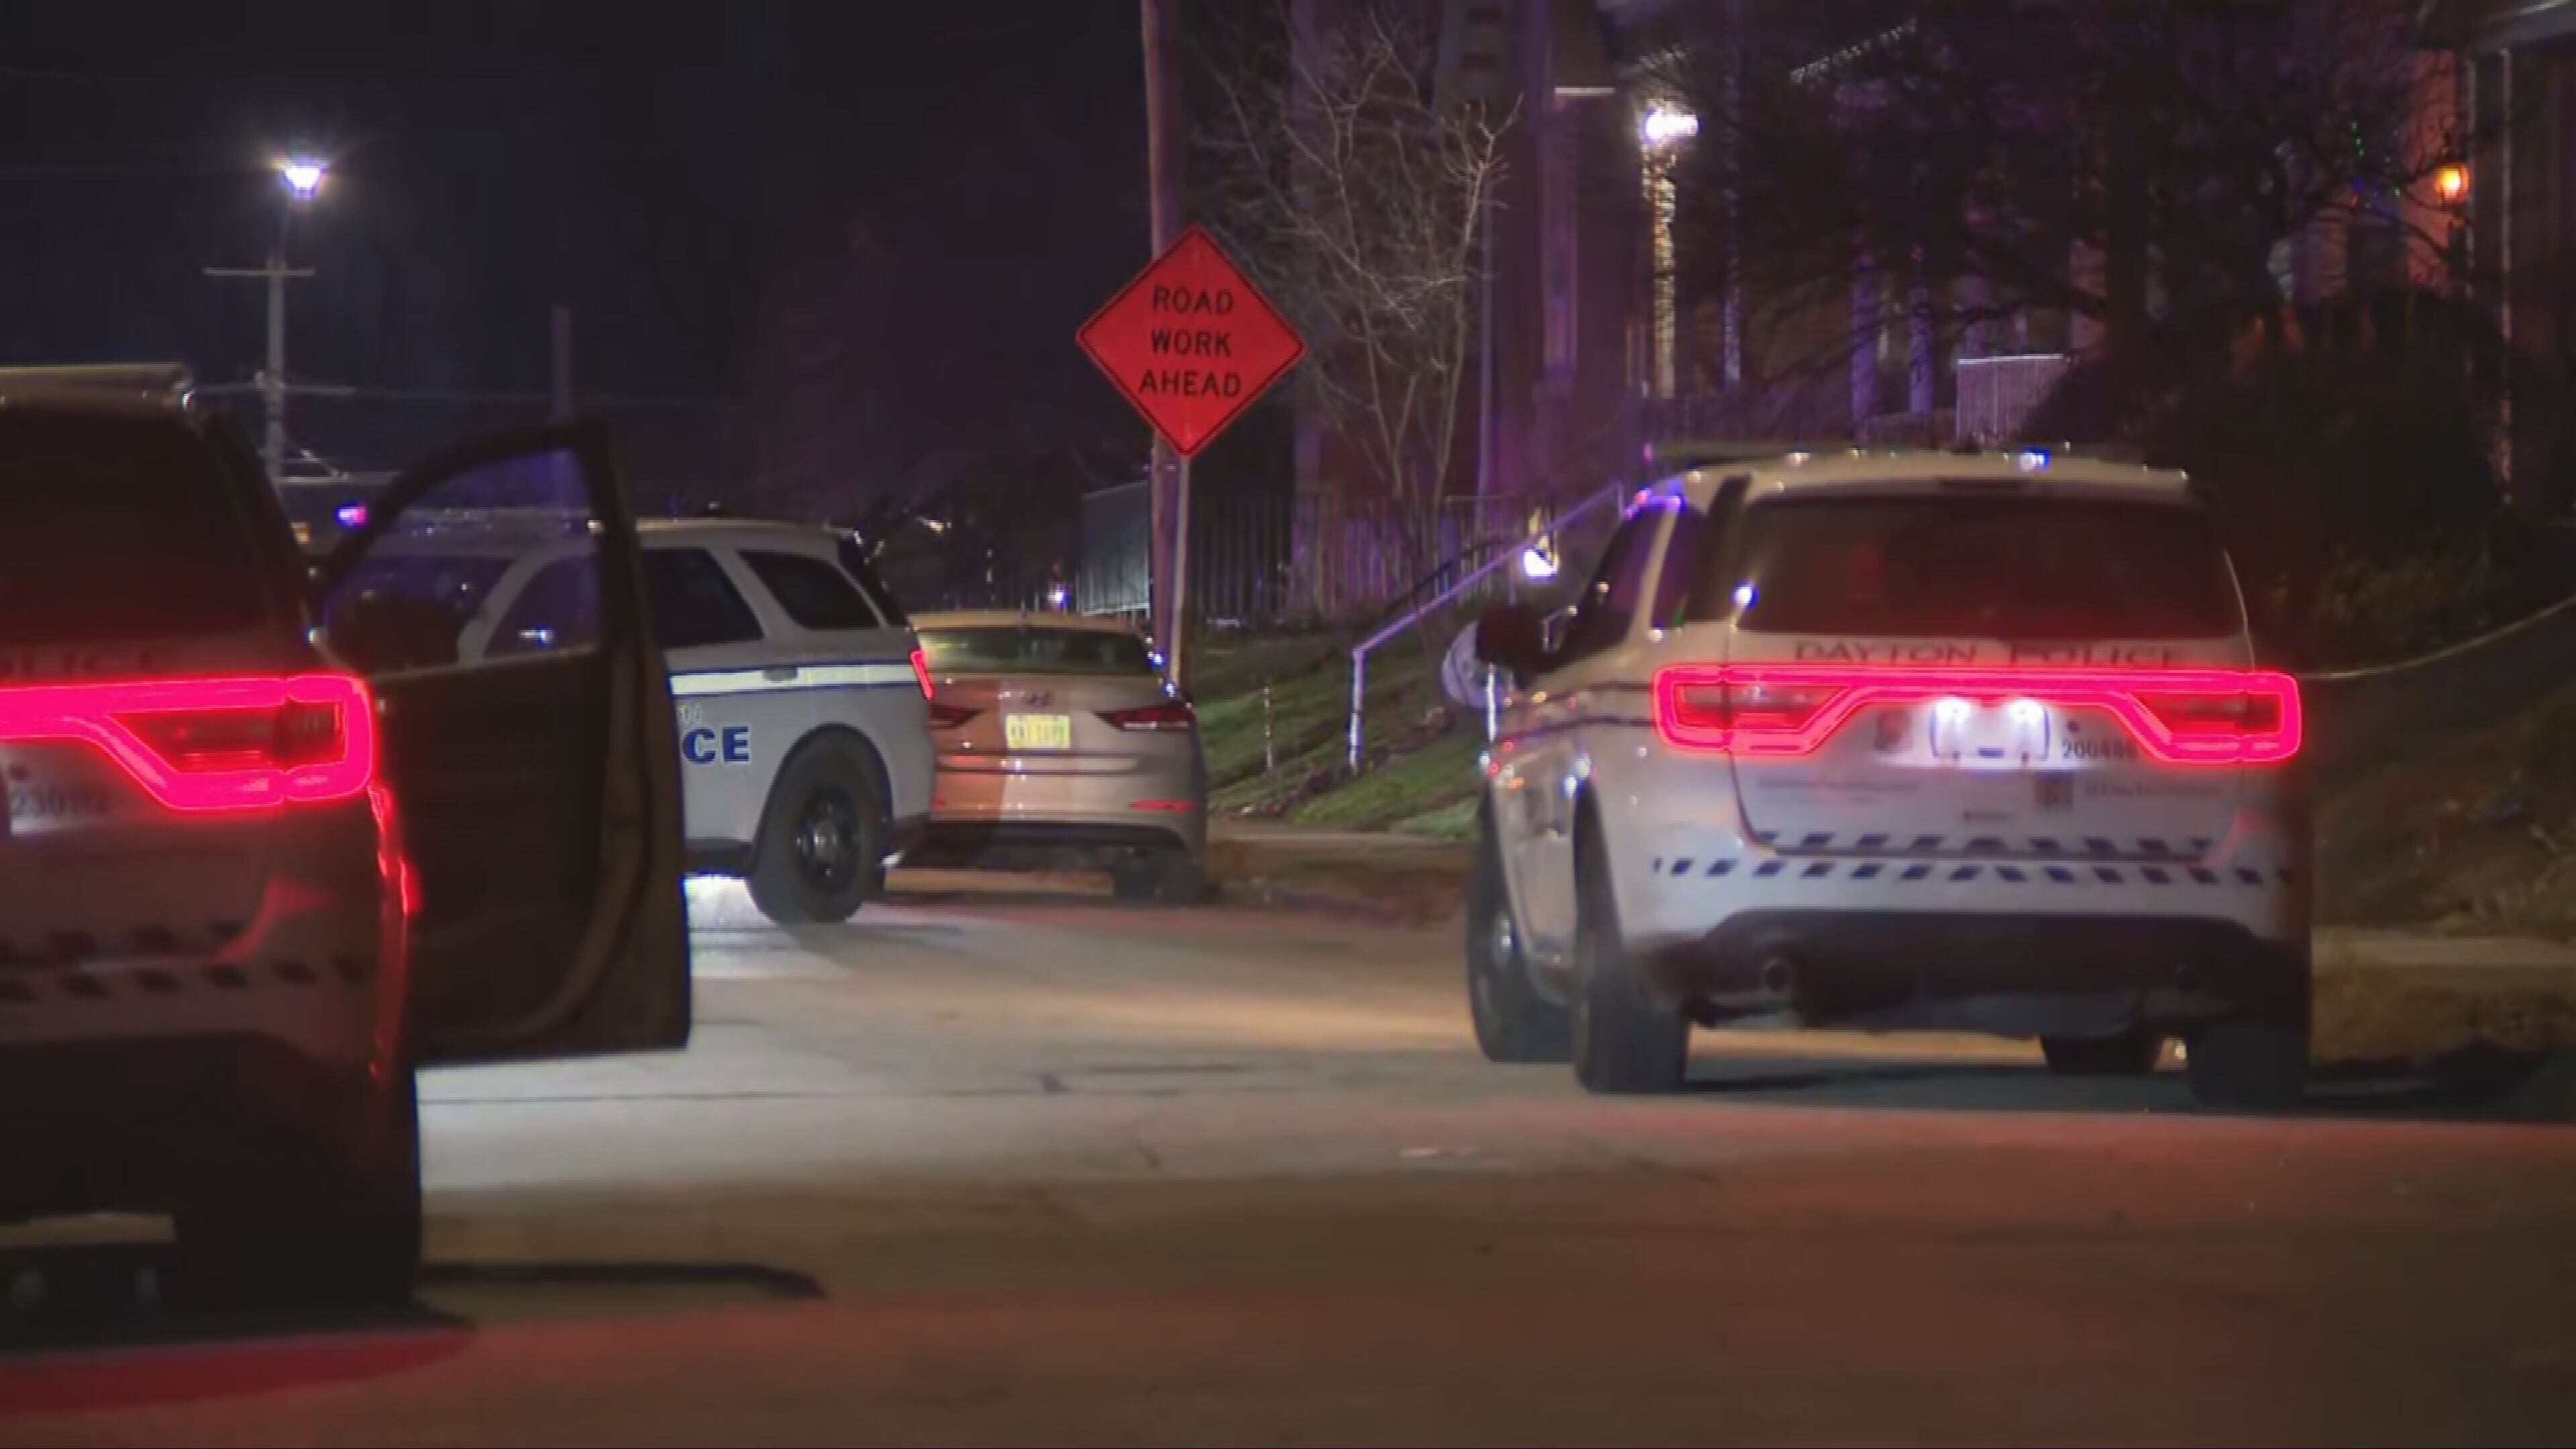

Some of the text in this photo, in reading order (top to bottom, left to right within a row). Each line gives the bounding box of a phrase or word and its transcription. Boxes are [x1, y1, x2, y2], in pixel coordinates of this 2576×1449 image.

[1153, 286, 1234, 314] ROAD
[1151, 329, 1231, 357] WORK
[1139, 370, 1241, 398] AHEAD
[1796, 642, 1976, 663] DAYTON
